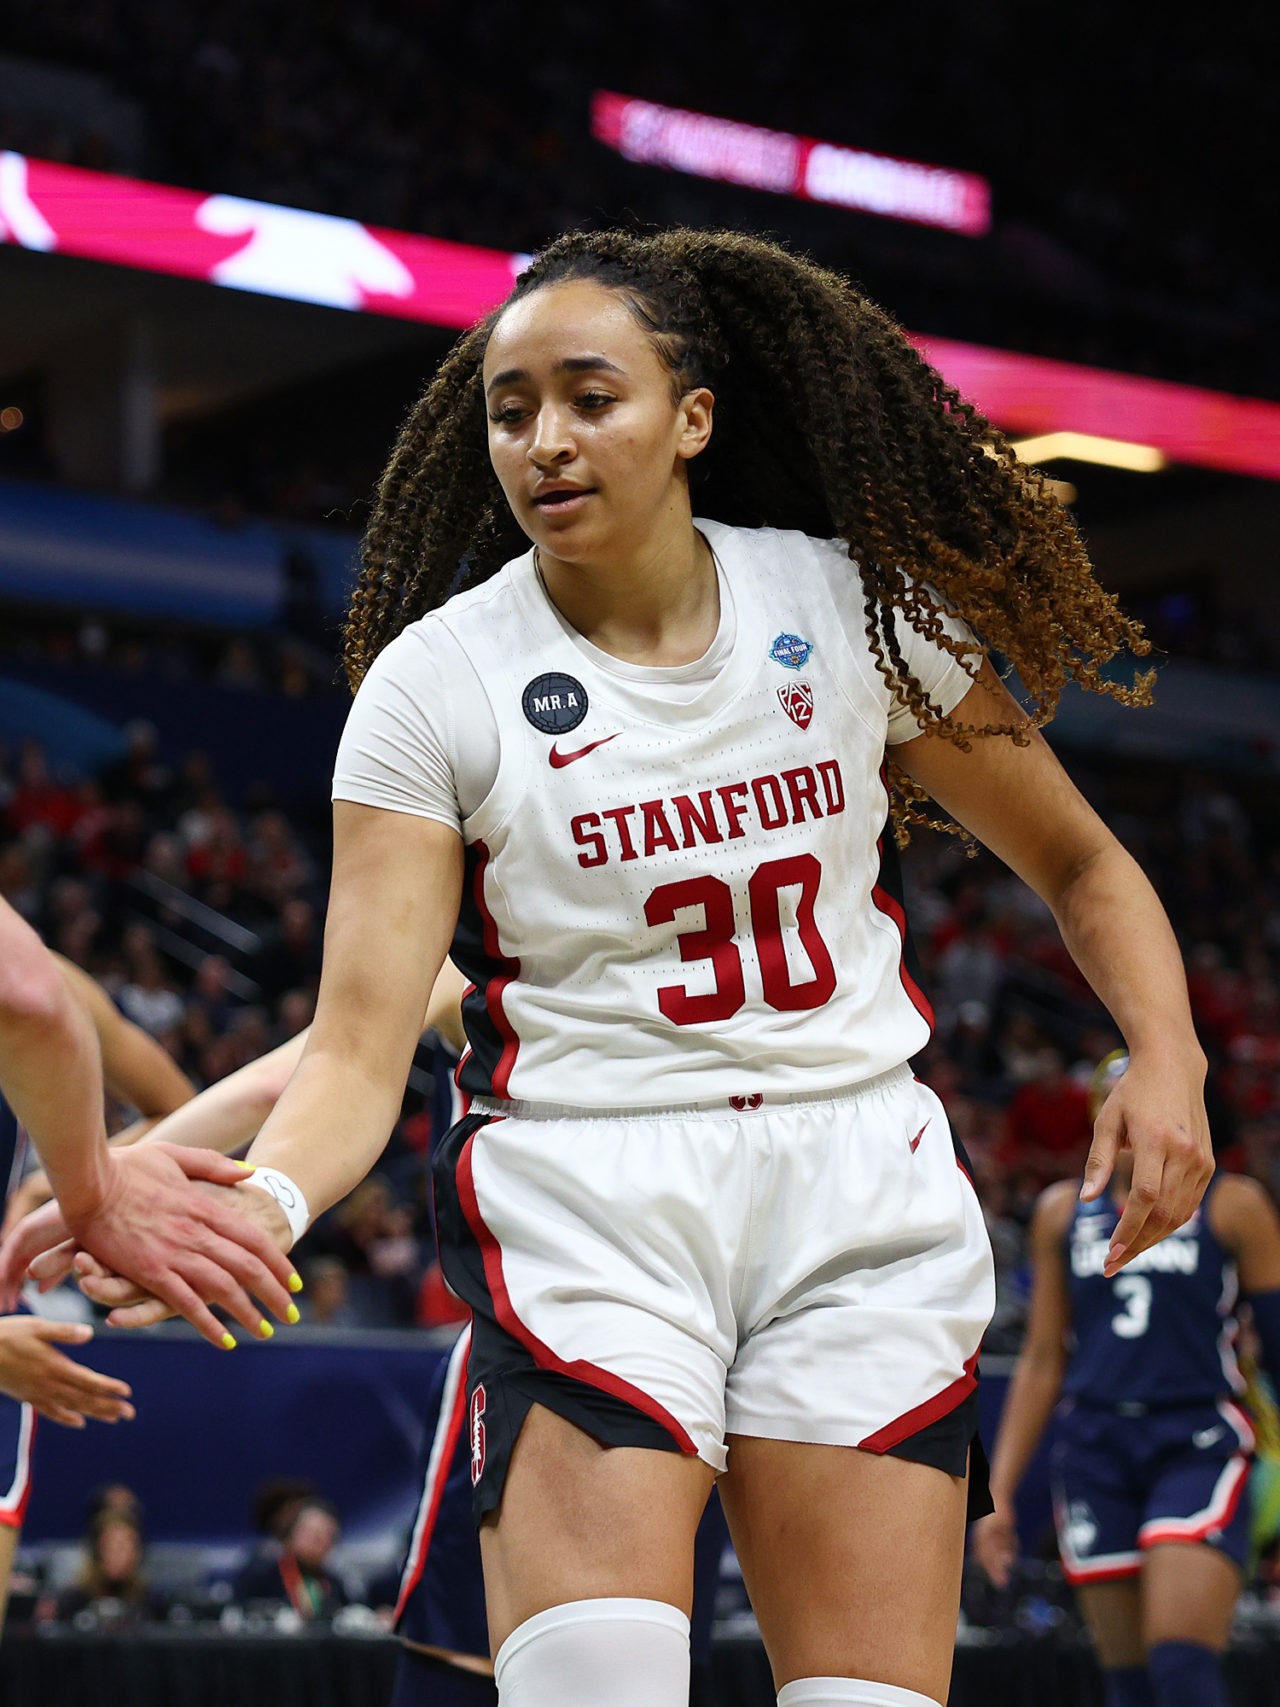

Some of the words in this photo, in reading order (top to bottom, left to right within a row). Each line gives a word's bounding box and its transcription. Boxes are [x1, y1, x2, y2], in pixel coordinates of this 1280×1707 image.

[773, 647, 792, 657] FINAL
[790, 643, 808, 653] FOUR
[778, 681, 813, 713] PAC
[790, 701, 810, 722] 12
[571, 759, 846, 868] STANFORD
[643, 852, 837, 1026] 30
[1111, 1274, 1152, 1339] 3
